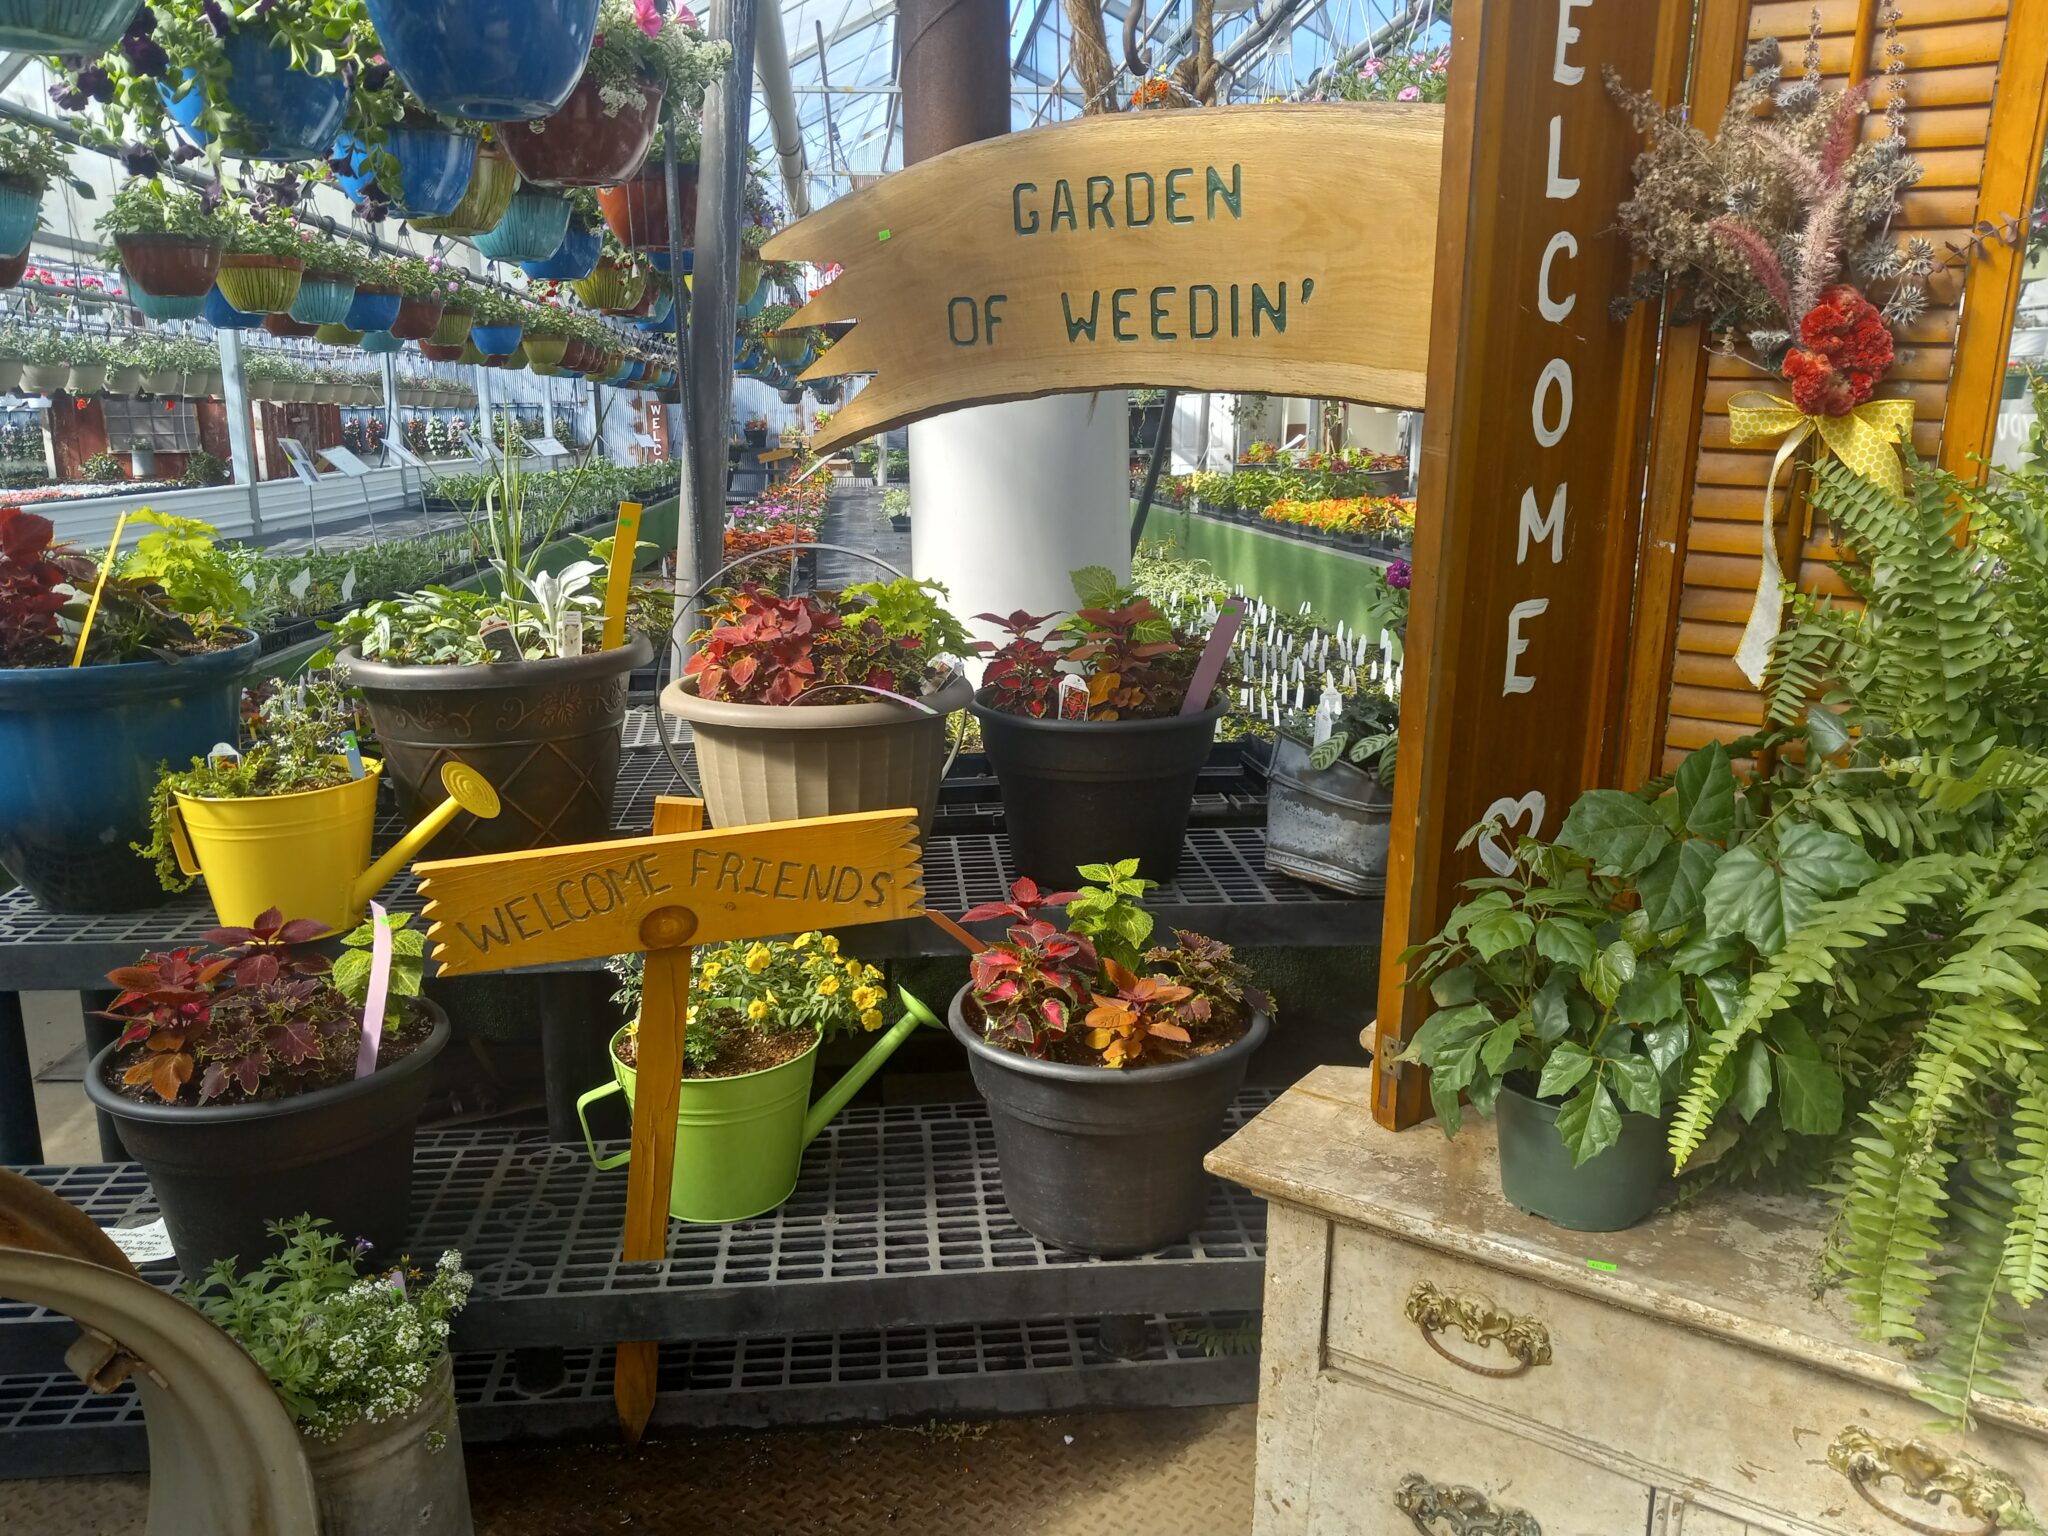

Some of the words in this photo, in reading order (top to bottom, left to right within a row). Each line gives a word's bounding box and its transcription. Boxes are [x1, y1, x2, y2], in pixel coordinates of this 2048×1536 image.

[1012, 162, 1243, 237] GARDEN
[947, 293, 1010, 347] OF
[1060, 277, 1315, 344] WEEDIN'
[456, 852, 672, 954] WELCOME
[690, 848, 895, 909] FRIENDS
